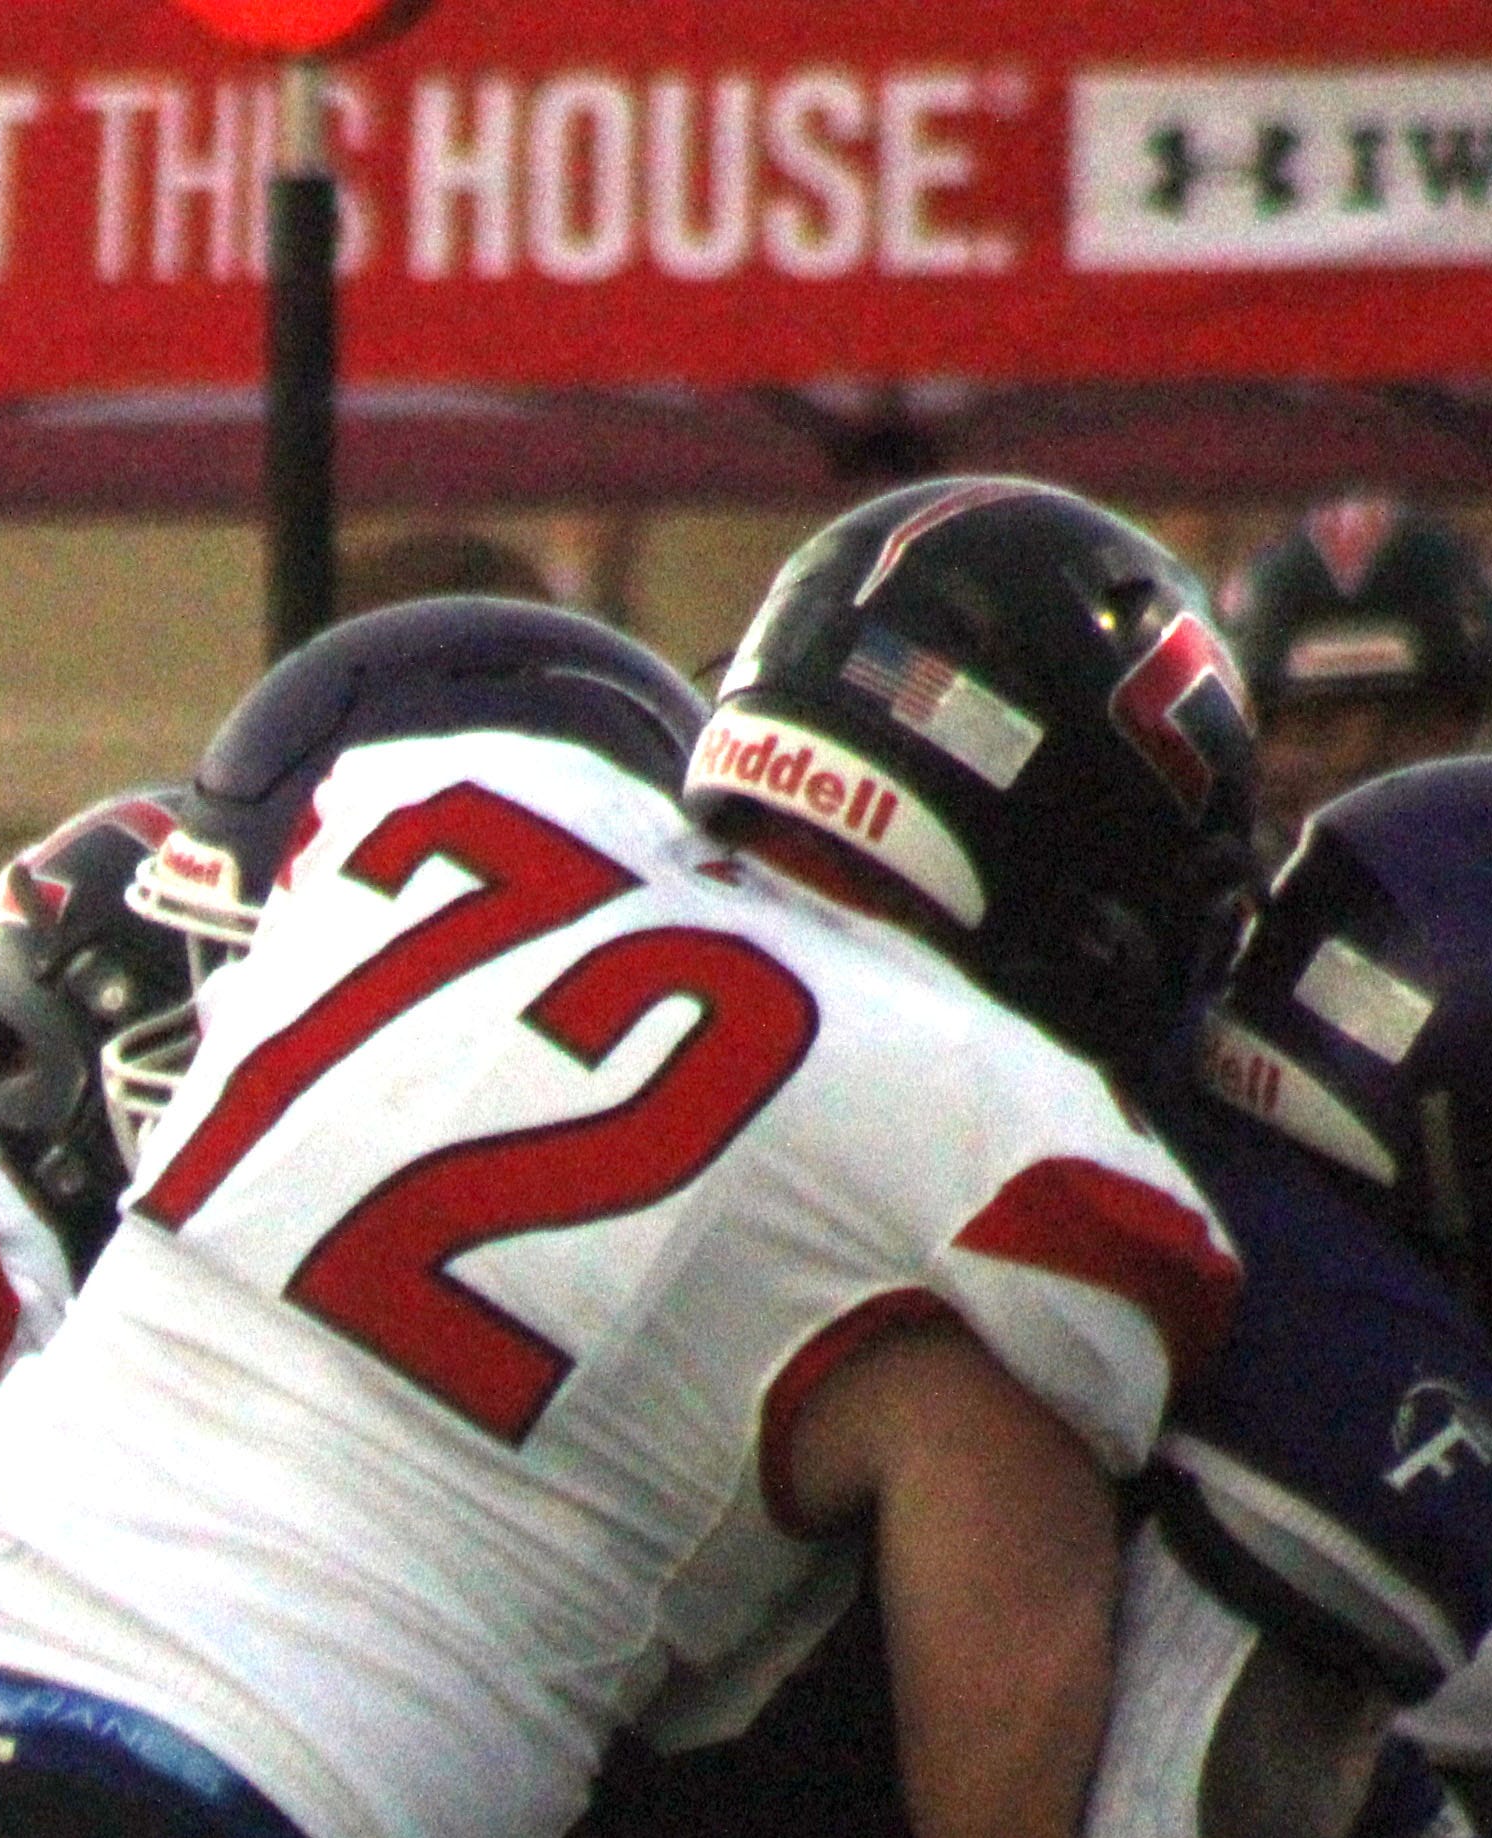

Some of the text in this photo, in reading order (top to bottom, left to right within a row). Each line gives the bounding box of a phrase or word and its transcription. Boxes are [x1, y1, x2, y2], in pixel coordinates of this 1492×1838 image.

[697, 728, 899, 844] Riddell
[163, 850, 223, 889] iddell
[131, 780, 820, 1453] 72
